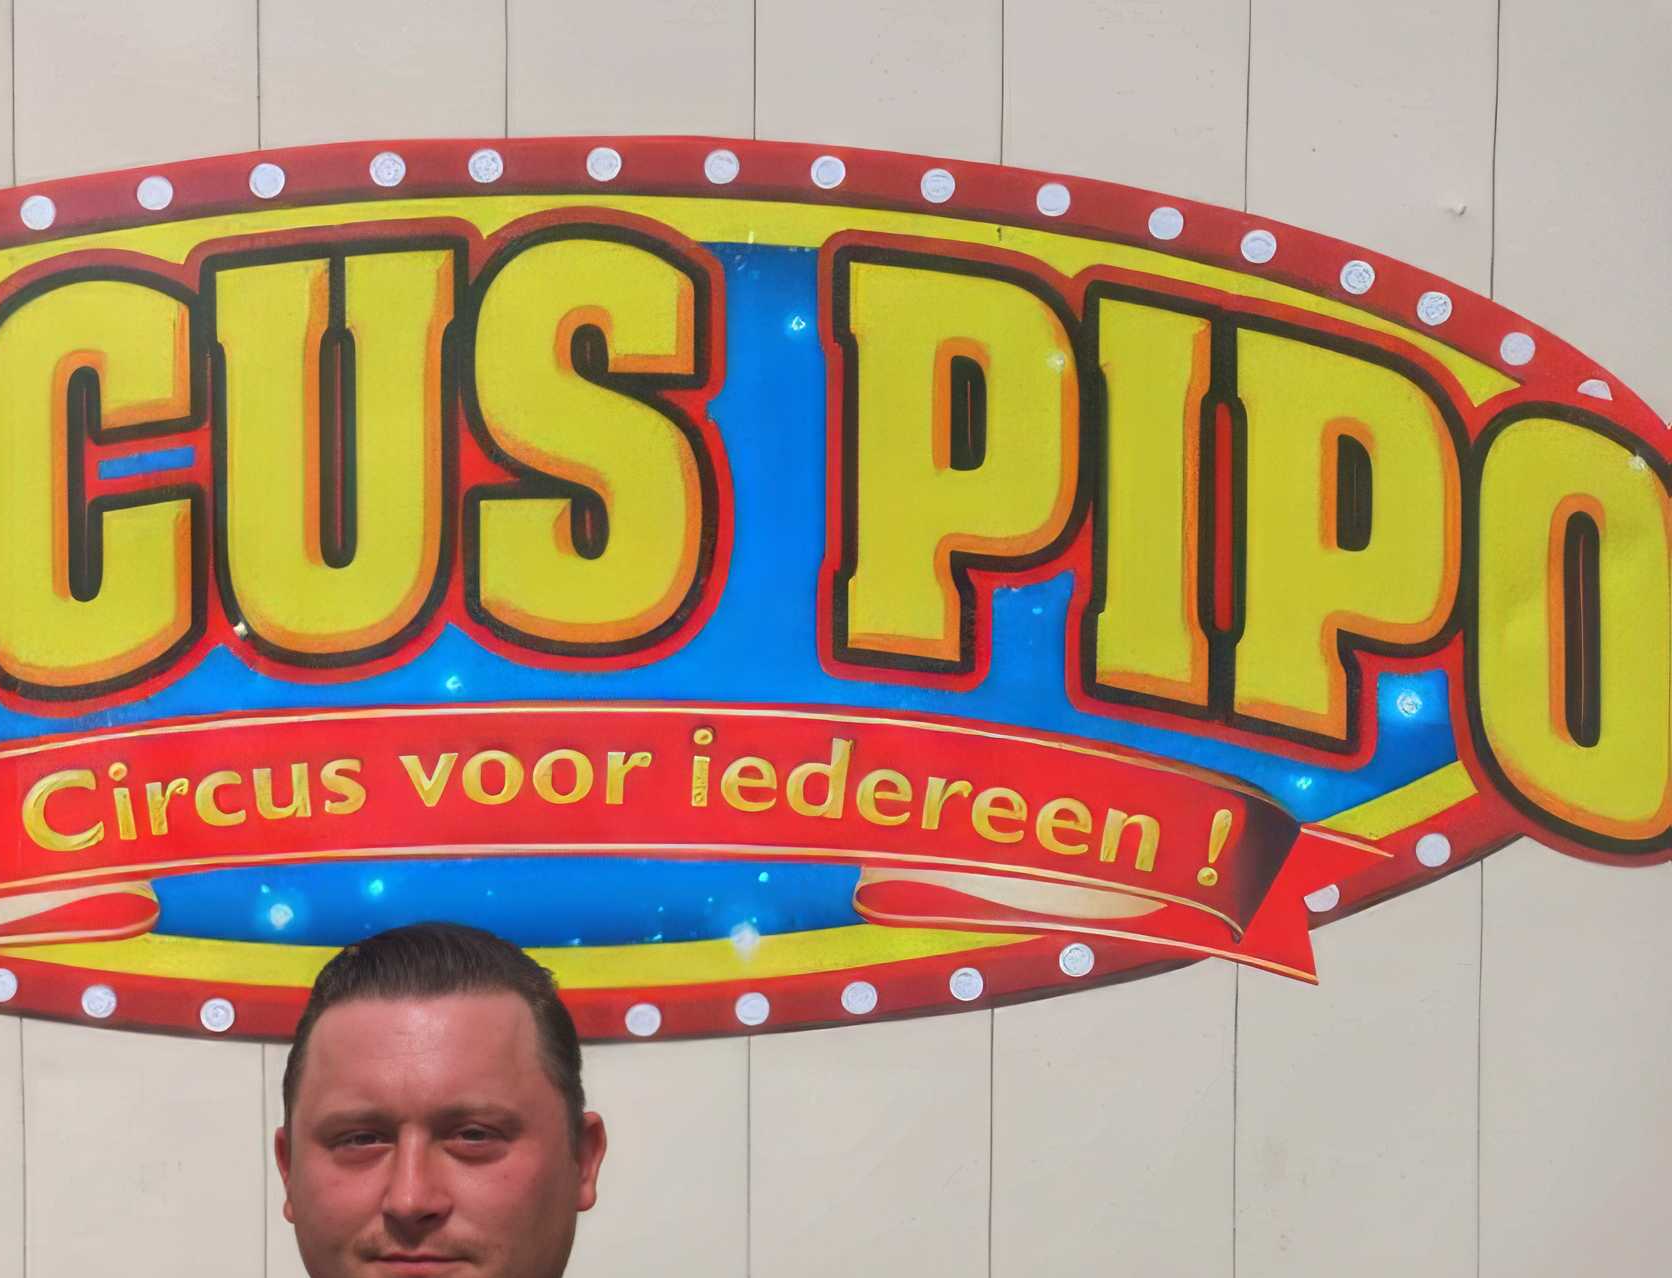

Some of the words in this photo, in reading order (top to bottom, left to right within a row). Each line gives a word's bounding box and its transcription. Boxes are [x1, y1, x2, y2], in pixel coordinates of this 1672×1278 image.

[832, 250, 1671, 842] PIPO
[20, 758, 368, 855] Circus
[398, 747, 654, 808] voor
[689, 726, 1162, 873] iedereen
[1195, 808, 1234, 888] !
